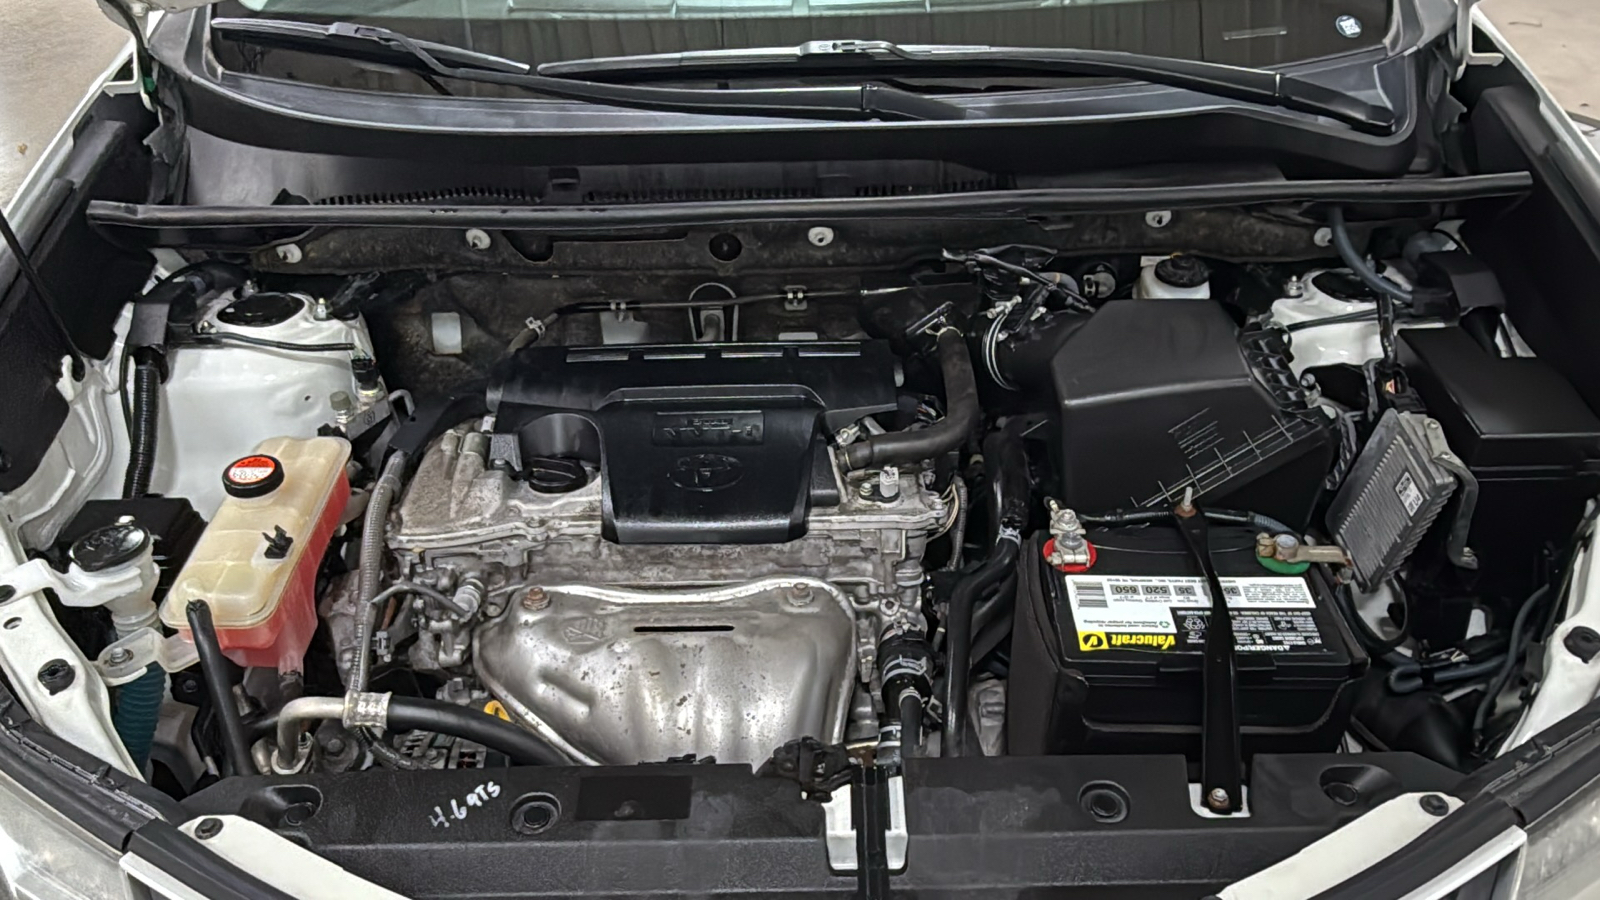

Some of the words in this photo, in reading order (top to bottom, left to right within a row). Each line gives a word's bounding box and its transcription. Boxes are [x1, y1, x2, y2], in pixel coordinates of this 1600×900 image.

[1115, 586, 1137, 594] 650
[1145, 586, 1168, 594] 520
[1178, 586, 1192, 594] 35
[1111, 634, 1175, 650] Valucraft
